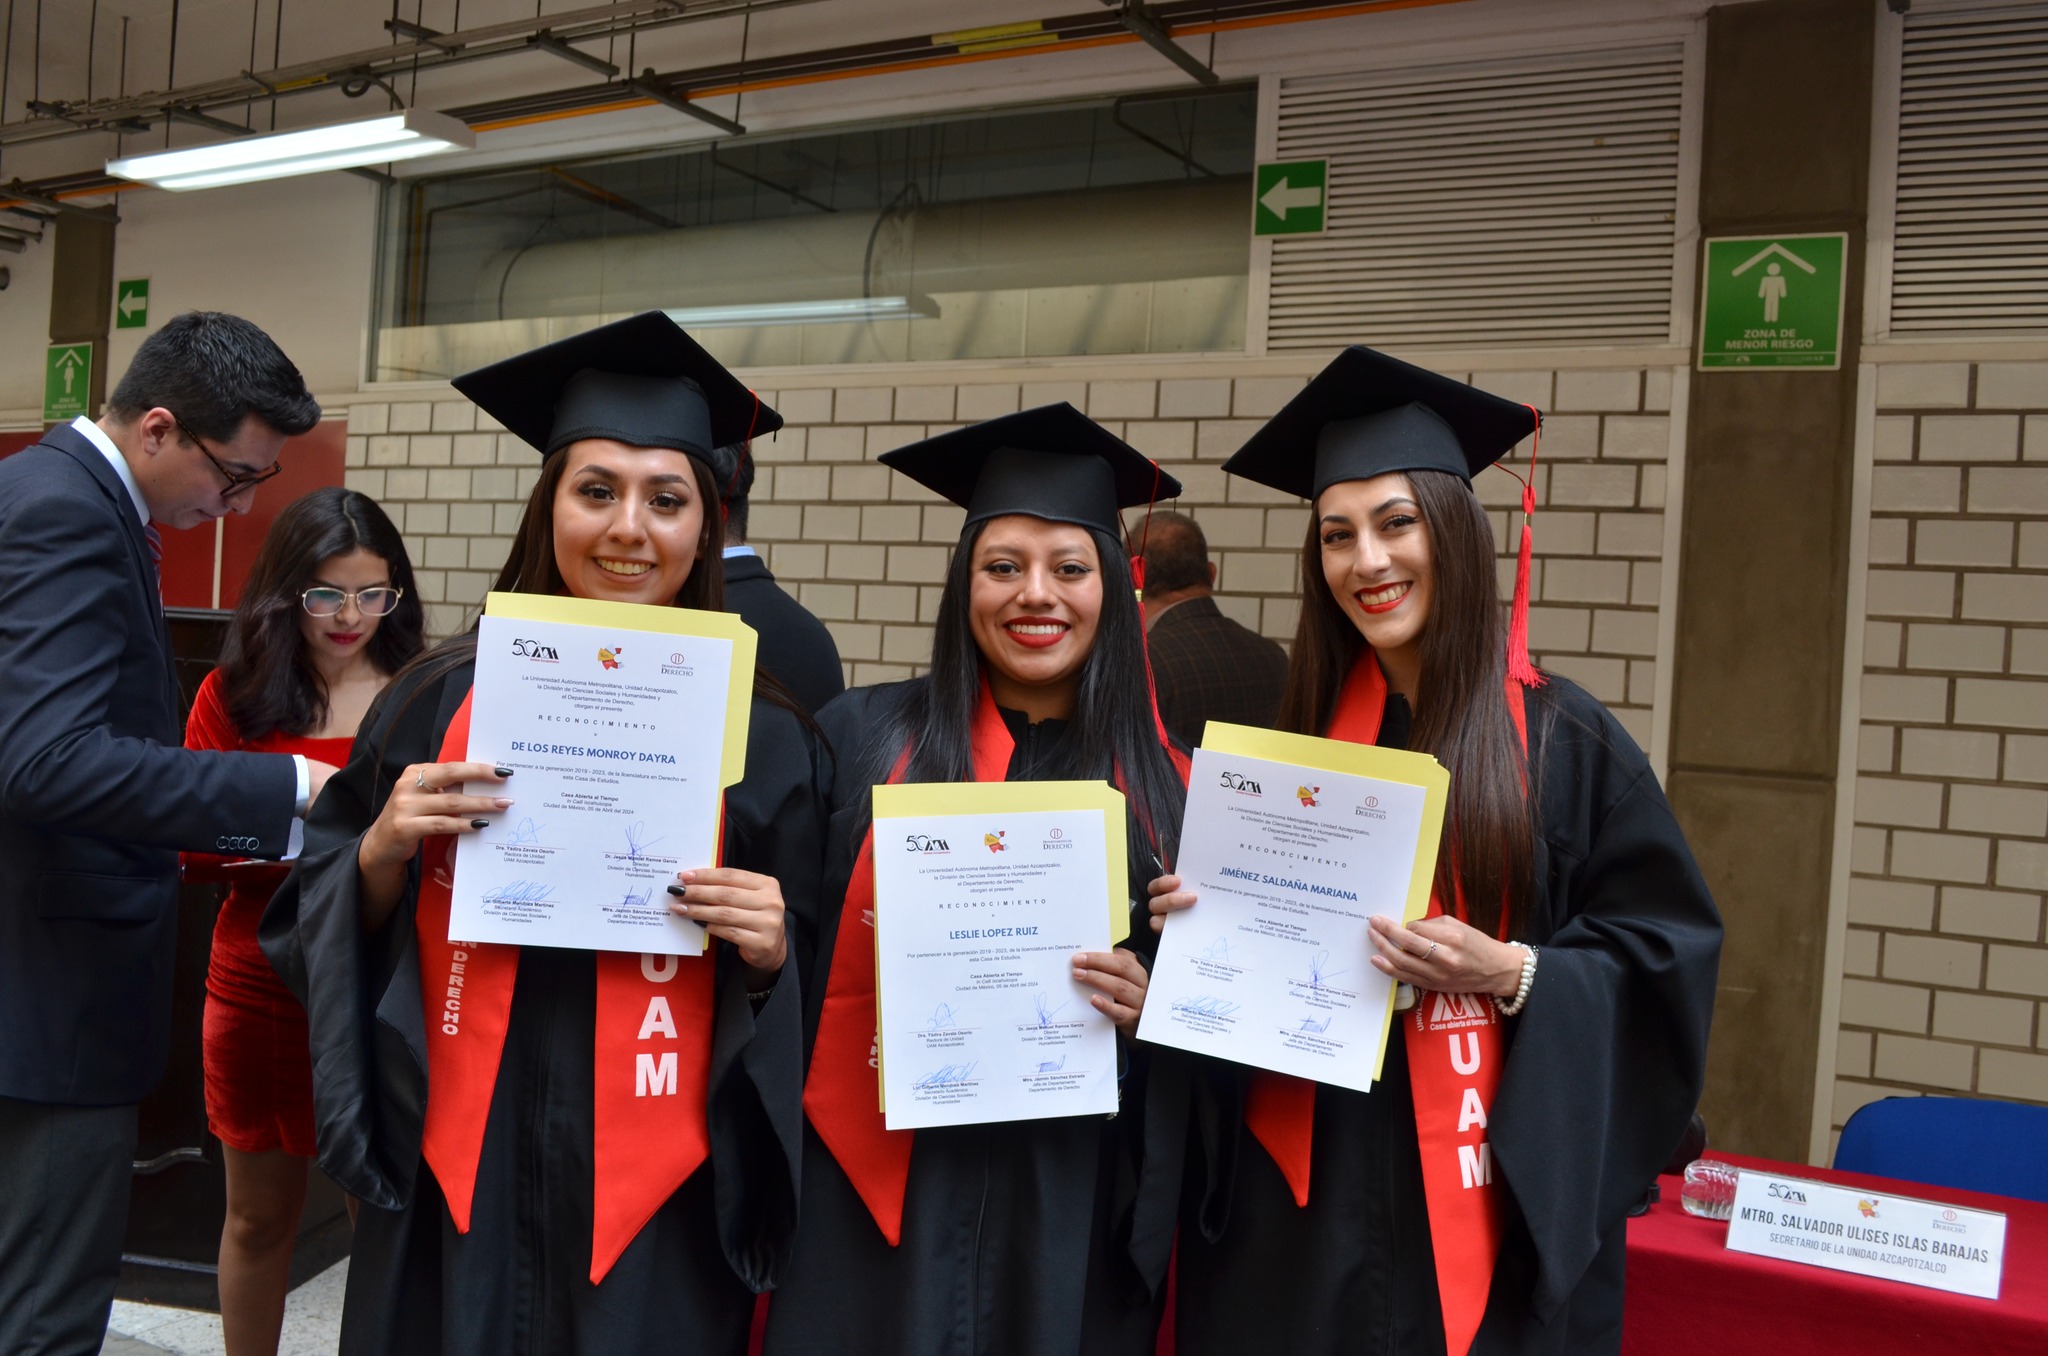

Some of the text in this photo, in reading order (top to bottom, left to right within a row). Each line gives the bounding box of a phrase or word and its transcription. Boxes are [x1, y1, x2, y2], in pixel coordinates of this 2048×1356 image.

[1743, 328, 1796, 339] ZONA DE
[1725, 339, 1814, 350] MENOR RIESGO
[529, 675, 560, 684] Universidad
[560, 678, 587, 686] Autónoma
[587, 680, 624, 690] Metropolitana,
[643, 686, 678, 695] Azcapotzalco,
[571, 686, 594, 694] Ciencias
[594, 689, 617, 697] Sociales
[621, 691, 657, 700] Humanidades
[567, 694, 604, 703] Departamento
[611, 698, 635, 706] Derecho,
[537, 714, 656, 731] RECONOCIMIENTO
[511, 741, 676, 765] DE LOS REYES MONROY DAYRA
[620, 771, 650, 779] licenciatura
[657, 774, 680, 782] Derecho
[1234, 806, 1262, 816] Universidad
[1261, 811, 1286, 821] Autónoma
[1286, 815, 1319, 827] Metropolitana,
[1320, 822, 1338, 830] Unidad
[1337, 825, 1370, 836] Azcapotzalco,
[1245, 815, 1264, 824] División
[1271, 820, 1292, 829] Ciencias
[1292, 824, 1313, 833] Sociales
[1316, 828, 1350, 840] Humanidades
[1267, 826, 1301, 838] Departamento
[1307, 834, 1329, 843] Derecho,
[1239, 843, 1347, 869] RECONOCIMIENTO
[1218, 866, 1358, 902] JIMÉNEZ SALDAÑA MARIANA
[938, 898, 1046, 909] RECONOCIMIENTO
[1208, 884, 1234, 893] pertenecer
[1242, 891, 1269, 900] generación
[1268, 895, 1281, 903] 2019
[1284, 898, 1298, 907] 2023,
[1310, 904, 1338, 914] licenciatura
[1344, 910, 1366, 920] Derecho
[1268, 902, 1281, 910] Casa
[1288, 906, 1309, 916] Estudios.
[949, 926, 1038, 940] LESLIE LOPEZ RUIZ
[442, 950, 468, 1036] DERECHO
[1429, 1019, 1489, 1031] Casa abierta al tiempo
[1740, 1206, 1989, 1263] MTRO. SALVADOR ULISES ISLAS BARAJAS
[1769, 1232, 1947, 1274] SECRETARIO DE LA UNIDAD AZCAPOTZALCO
